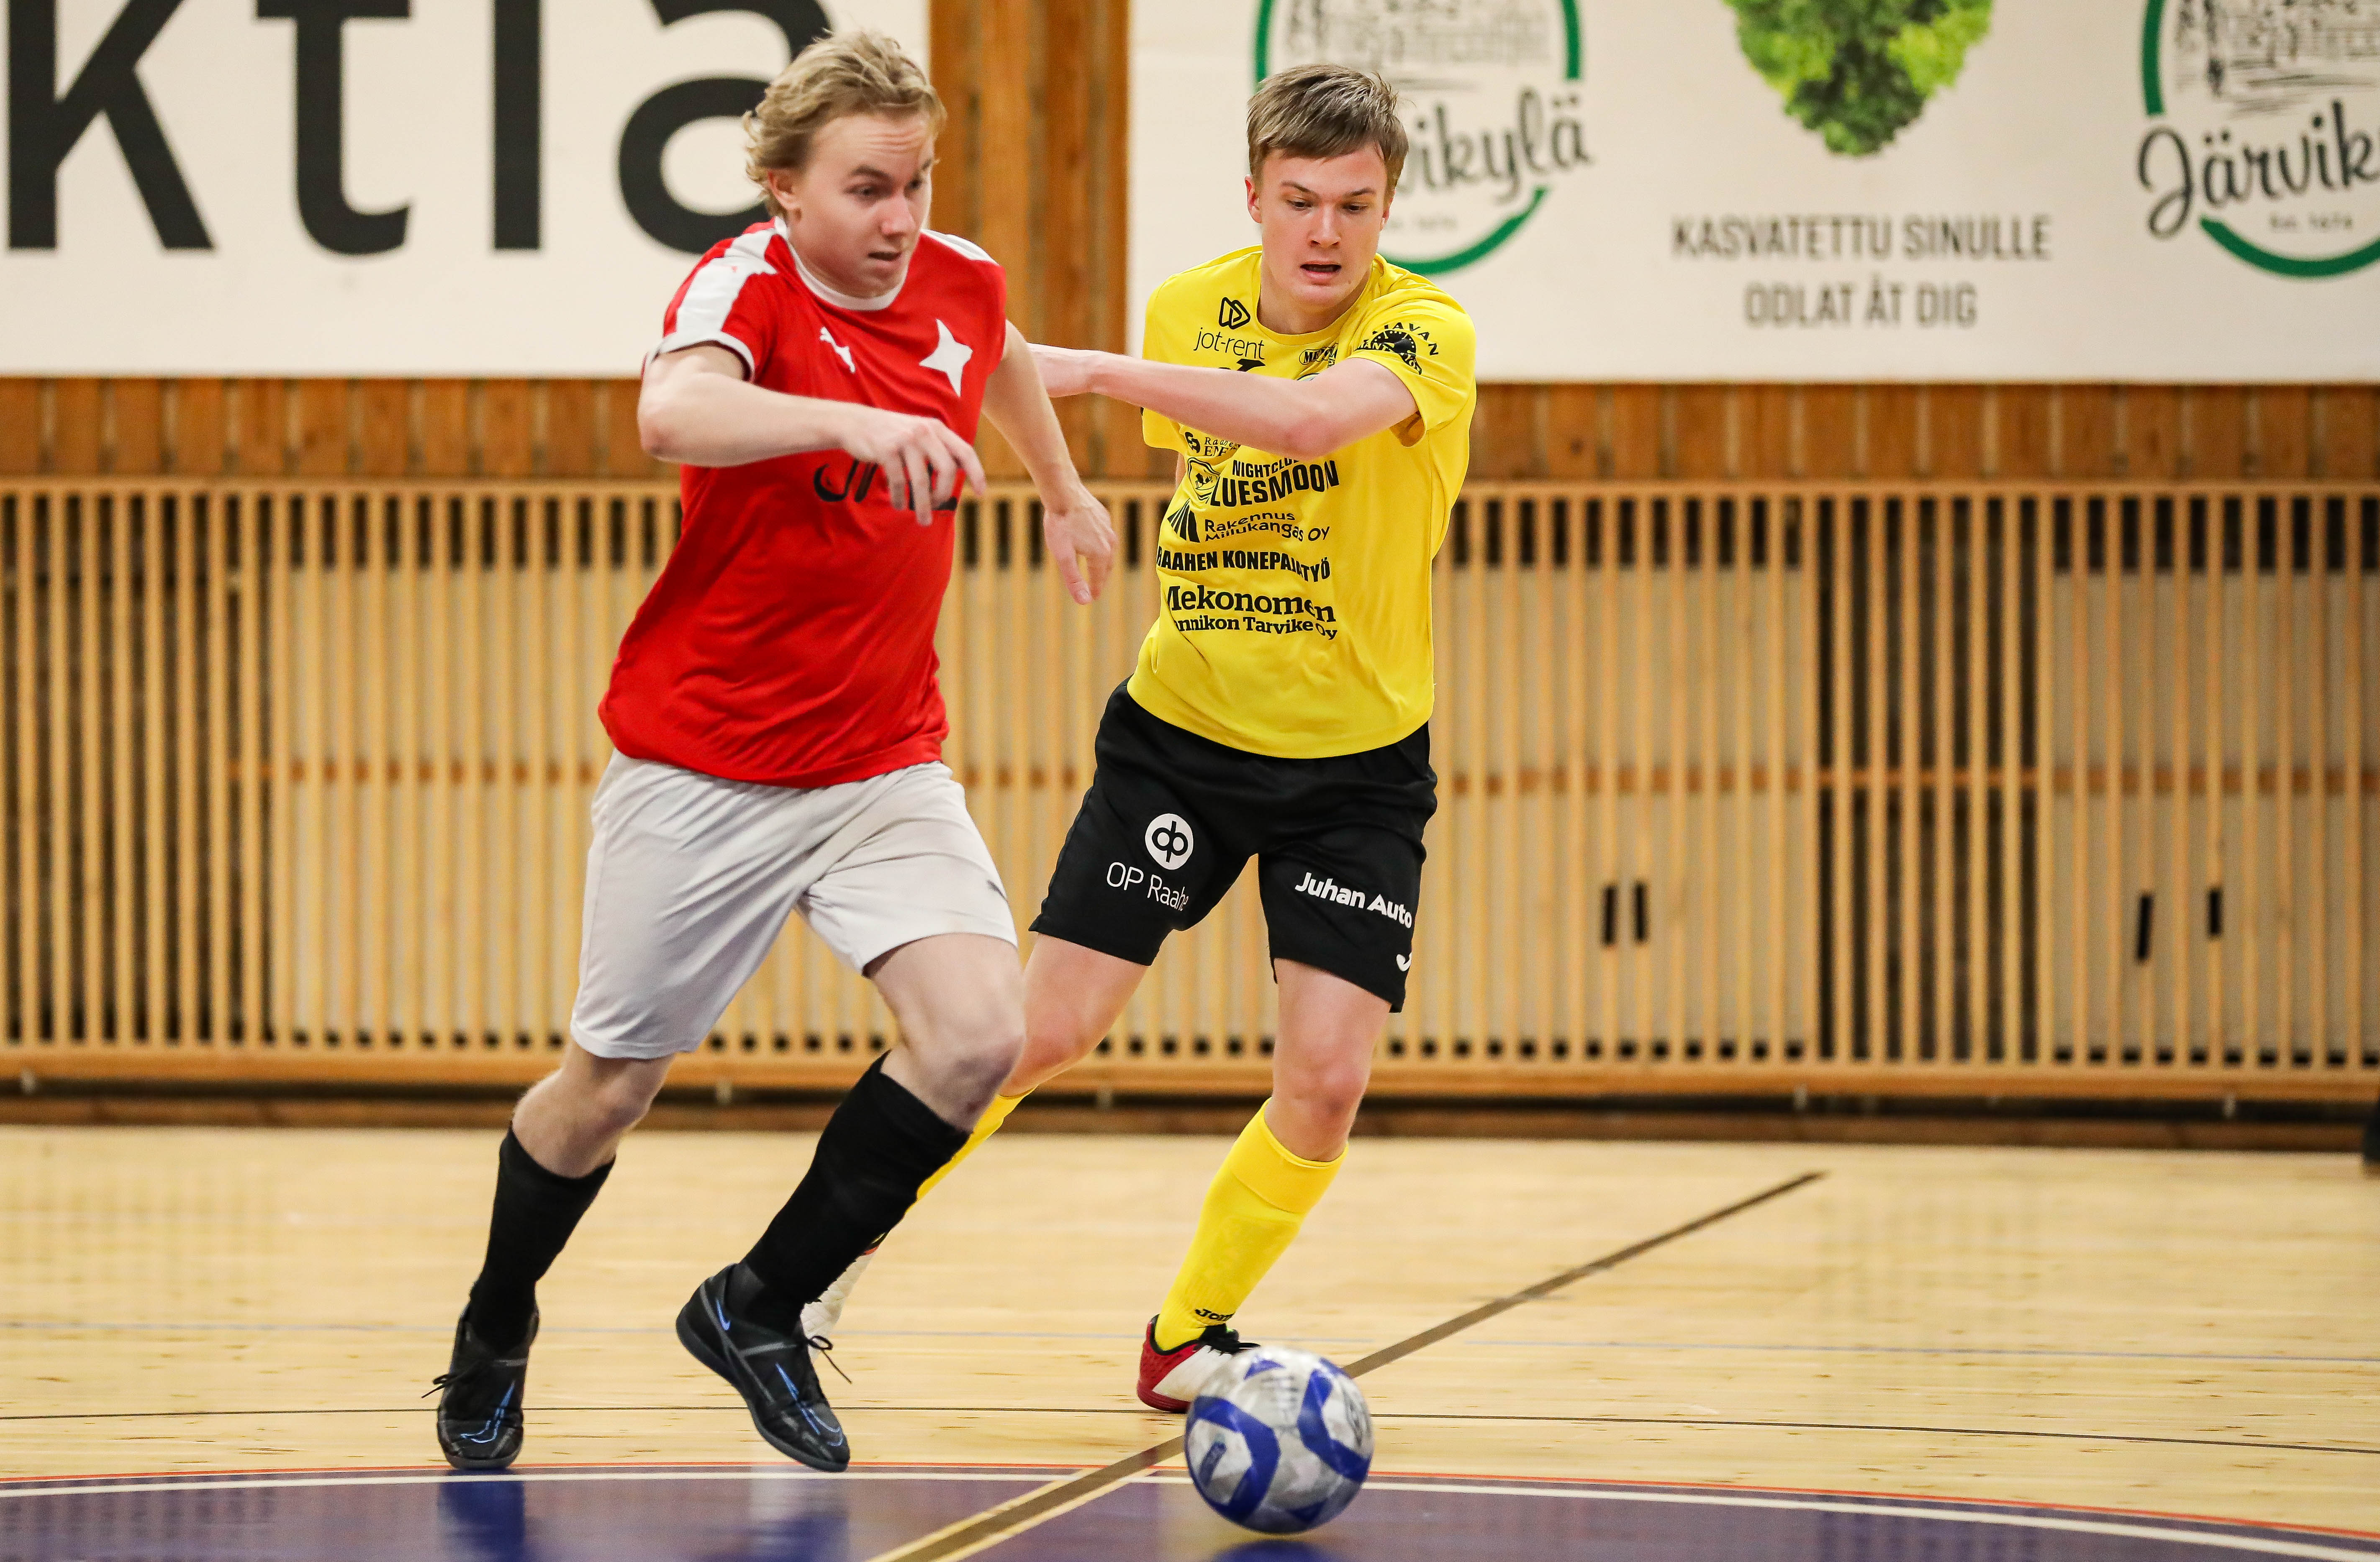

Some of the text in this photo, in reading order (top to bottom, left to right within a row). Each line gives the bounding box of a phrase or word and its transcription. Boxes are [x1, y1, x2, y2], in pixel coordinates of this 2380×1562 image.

[1672, 214, 2053, 260] KASVATETTU SINULLE
[1743, 273, 1978, 328] ODLAT ÅT DIG
[1194, 327, 1265, 360] jot-rent
[1209, 460, 1340, 507] LUESMOON
[1205, 513, 1295, 532] Rakennus
[1157, 546, 1330, 582] RAAHEN KONEPAJATYÖ
[1167, 585, 1336, 623] Mekonomen
[1243, 617, 1313, 634] Tarvike
[1315, 623, 1338, 640] Oy
[1107, 862, 1189, 911] OP Raahe
[1295, 872, 1412, 928] Juhan Auto
